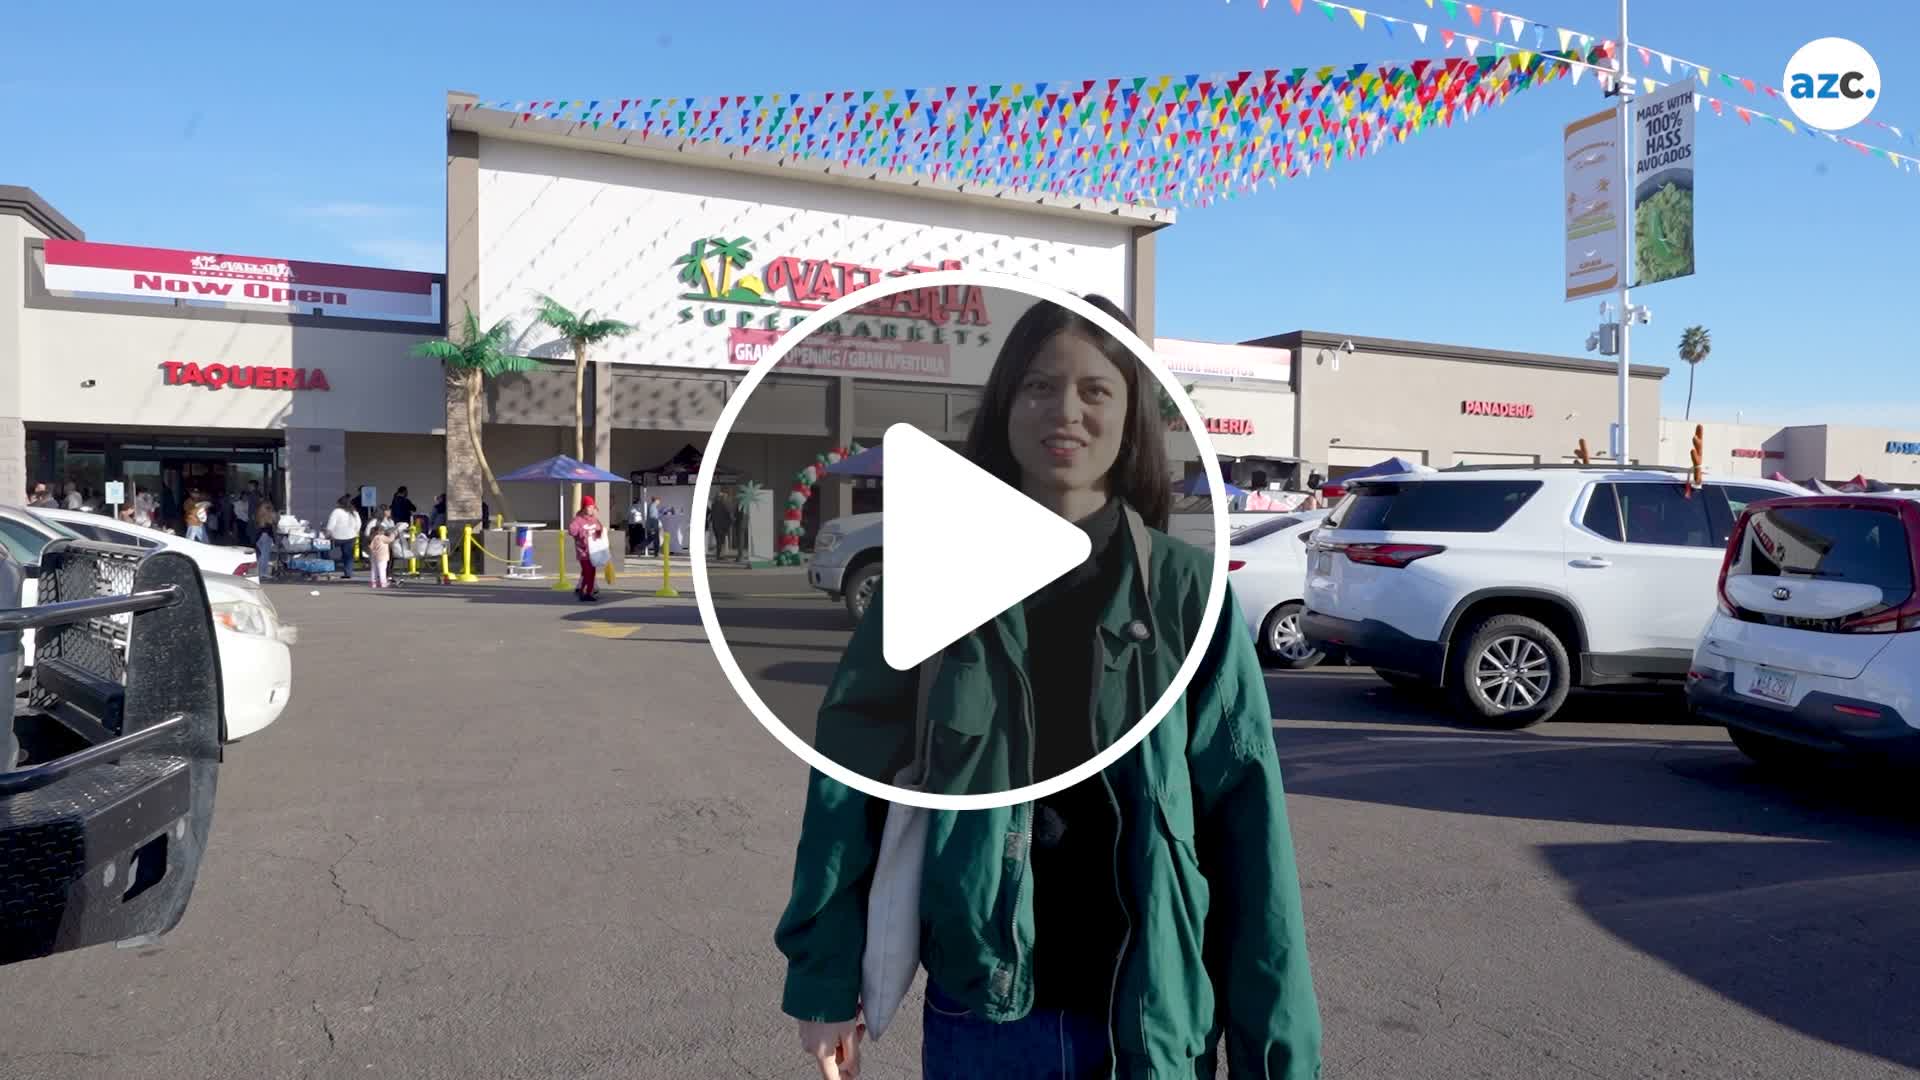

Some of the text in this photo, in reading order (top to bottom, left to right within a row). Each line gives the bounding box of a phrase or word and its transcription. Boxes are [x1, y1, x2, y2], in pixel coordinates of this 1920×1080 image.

[1636, 90, 1693, 122] MADE WITH
[1645, 110, 1683, 137] 100%
[1646, 128, 1682, 156] HASS
[1636, 143, 1692, 174] AVOCADOS
[133, 274, 348, 305] Now Open
[735, 342, 775, 361] GRAN
[160, 361, 330, 391] TAQUERIA
[1461, 400, 1535, 418] PANADERIA
